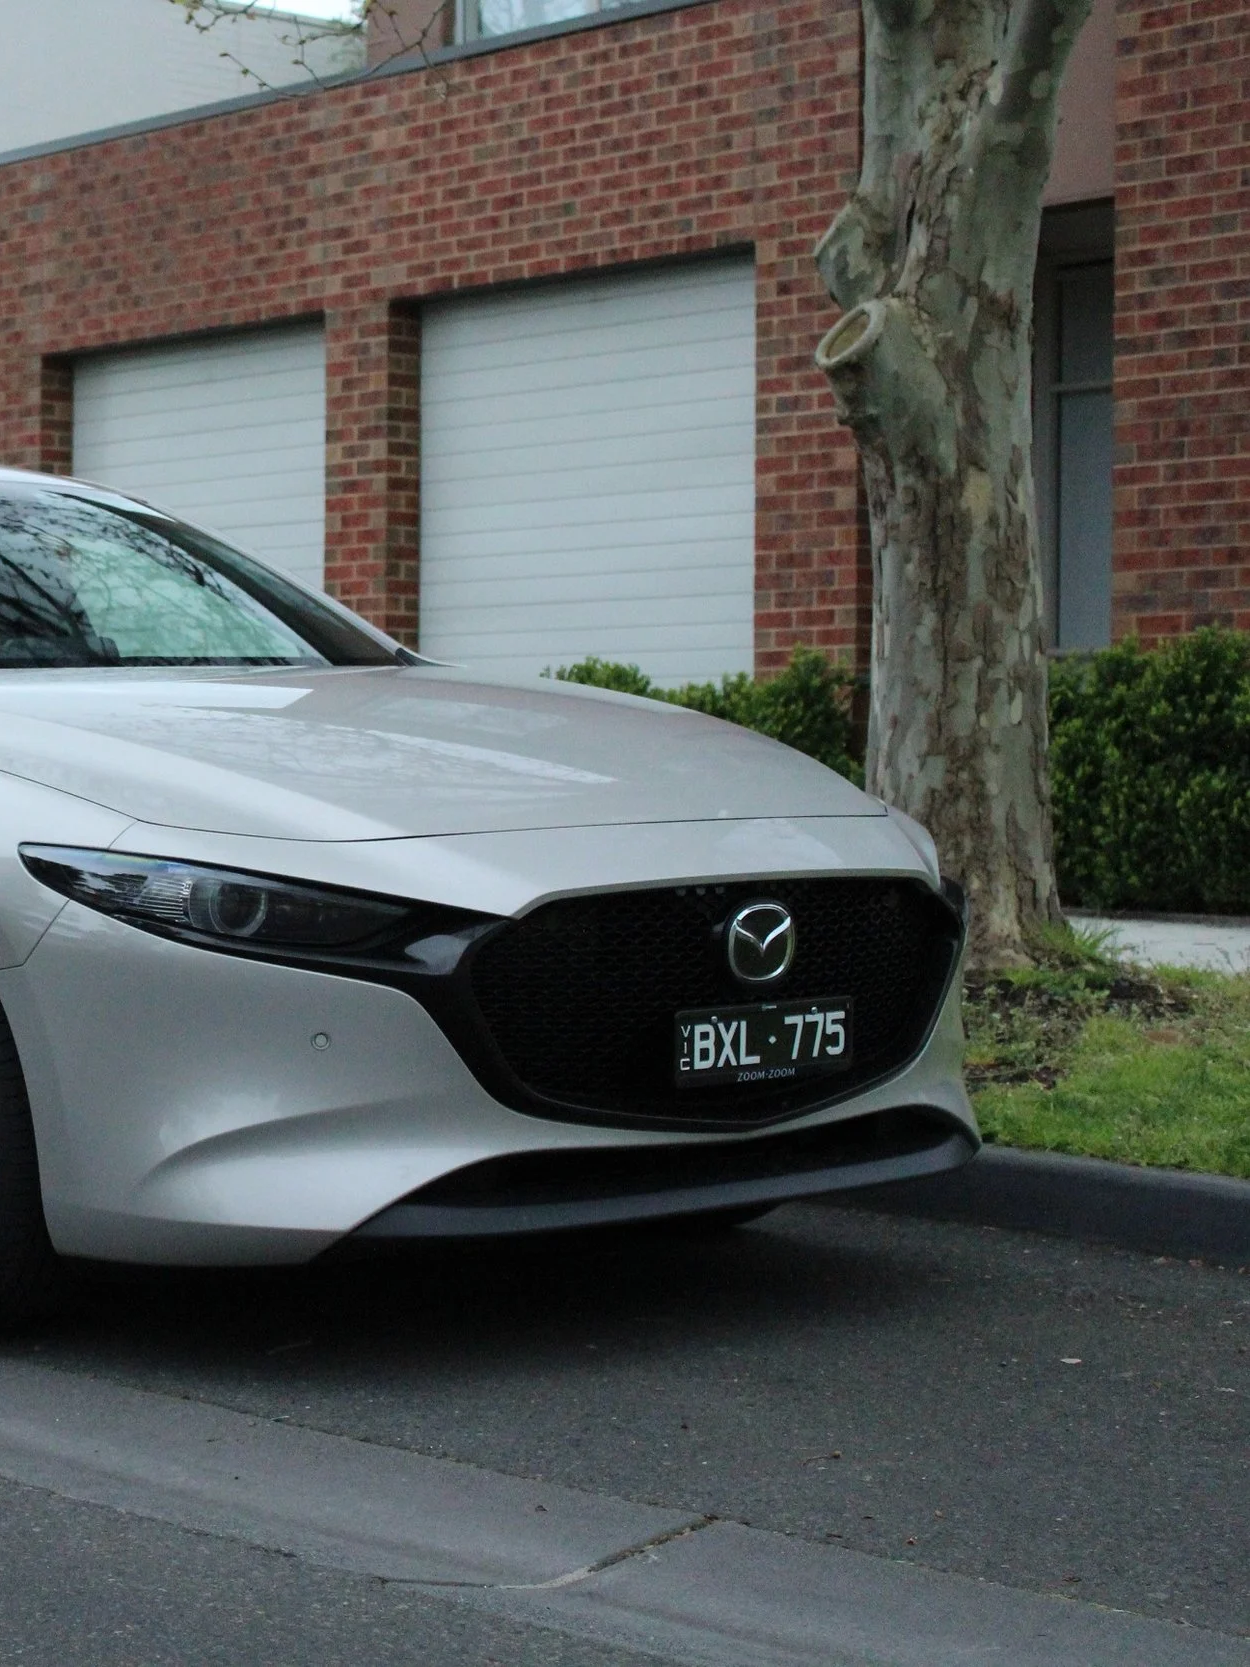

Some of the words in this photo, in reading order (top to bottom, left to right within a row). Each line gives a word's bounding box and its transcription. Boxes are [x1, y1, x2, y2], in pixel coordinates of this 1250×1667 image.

[680, 1025, 691, 1071] VIC
[693, 1020, 761, 1070] BXL
[784, 1010, 846, 1060] 775
